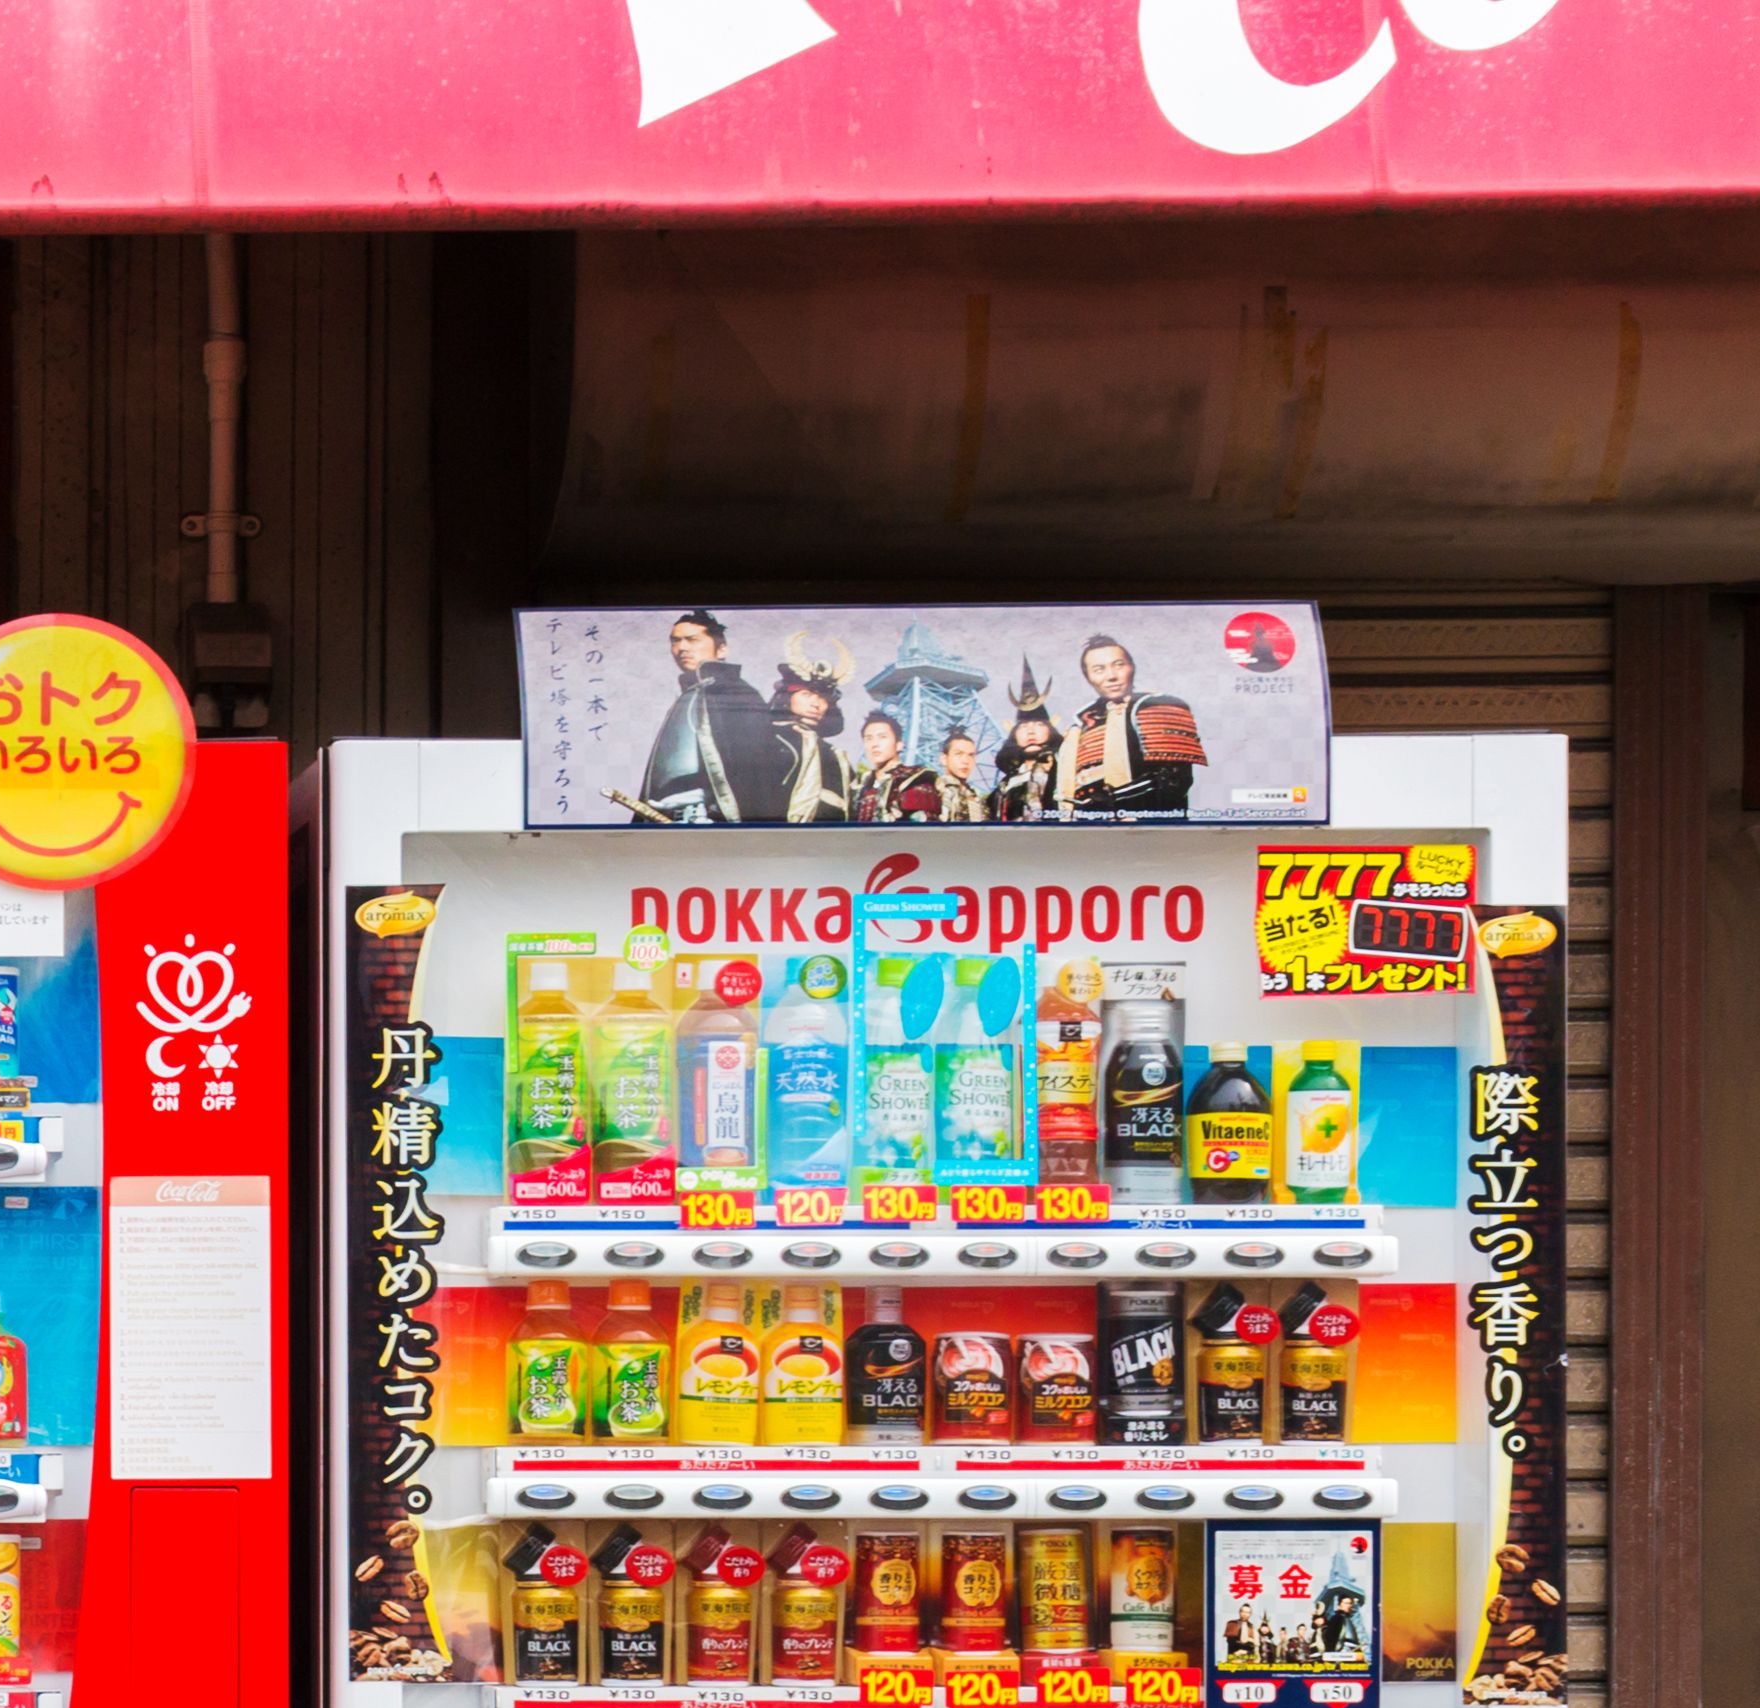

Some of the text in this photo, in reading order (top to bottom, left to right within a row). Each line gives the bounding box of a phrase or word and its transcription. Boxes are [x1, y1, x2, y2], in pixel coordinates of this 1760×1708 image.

[585, 625, 608, 742] その一本で
[546, 617, 572, 815] テレビ塔を守ろう
[1259, 853, 1403, 901] 7777
[775, 1071, 841, 1093] 天然水
[153, 1097, 180, 1112] ON
[201, 1097, 236, 1112] OFF
[527, 1076, 557, 1130] お茶
[681, 1193, 754, 1226] 130円
[777, 1190, 844, 1224] 120円
[370, 1024, 439, 1517] 丹精込めたコク。
[1474, 1071, 1542, 1458] 際立つ香り。
[1229, 1563, 1313, 1600] 募金
[527, 1639, 571, 1652] BLACK
[861, 1671, 934, 1706] 120円
[1234, 1685, 1265, 1700] ¥10
[1322, 1685, 1353, 1700] ¥50
